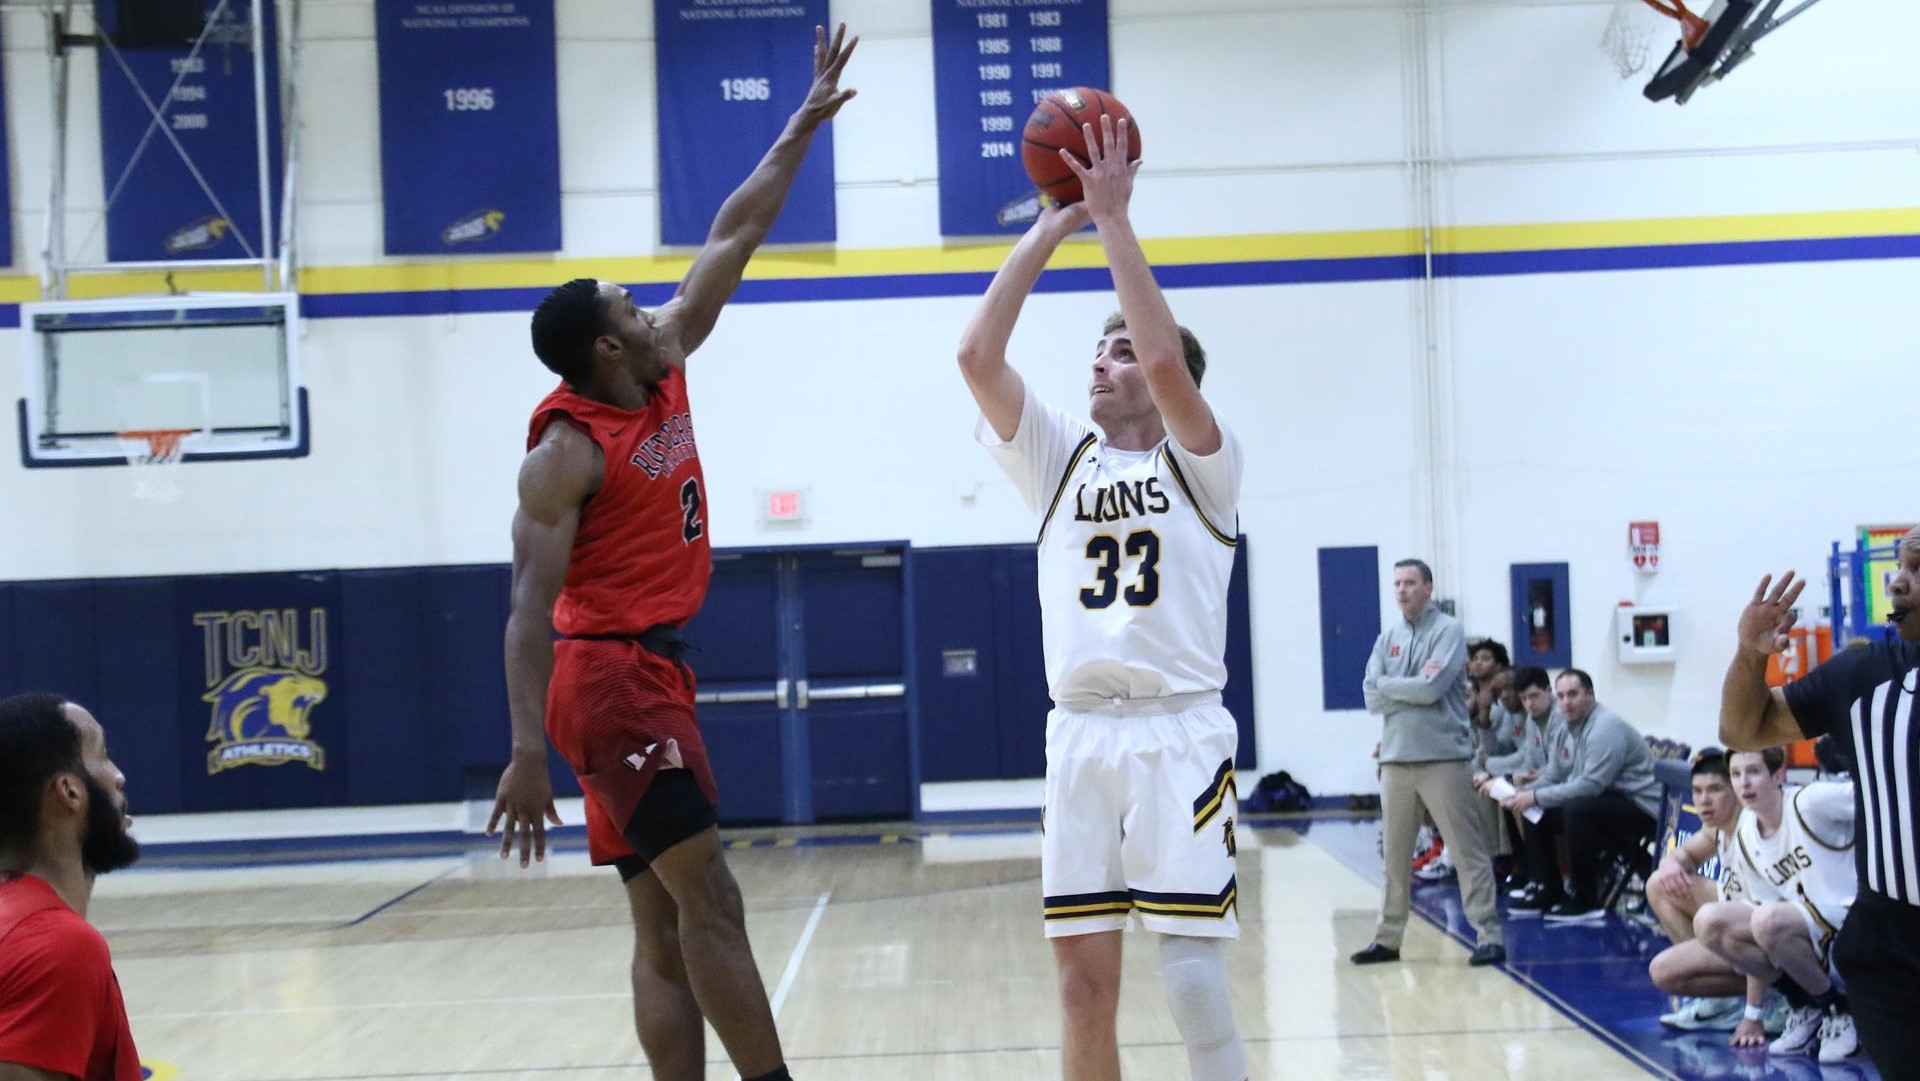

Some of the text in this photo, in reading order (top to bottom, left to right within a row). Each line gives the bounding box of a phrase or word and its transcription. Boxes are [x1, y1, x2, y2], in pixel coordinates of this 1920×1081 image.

[680, 7, 805, 19] NATIONAL CHAMPIONS
[977, 11, 1061, 28] 1981 1983
[978, 37, 1062, 54] 1985 1988
[978, 63, 1062, 80] 1990 1991
[720, 78, 771, 101] 1986
[980, 90, 1013, 106] 1995
[1031, 88, 1059, 104] 19
[443, 88, 494, 111] 1996
[981, 116, 1014, 132] 1999
[982, 142, 1014, 158] 2014
[1074, 477, 1170, 523] LIONS
[679, 477, 703, 545] 2
[1079, 528, 1161, 610] 33
[193, 607, 328, 687] TCNJ
[220, 741, 313, 760] ATHLETICS
